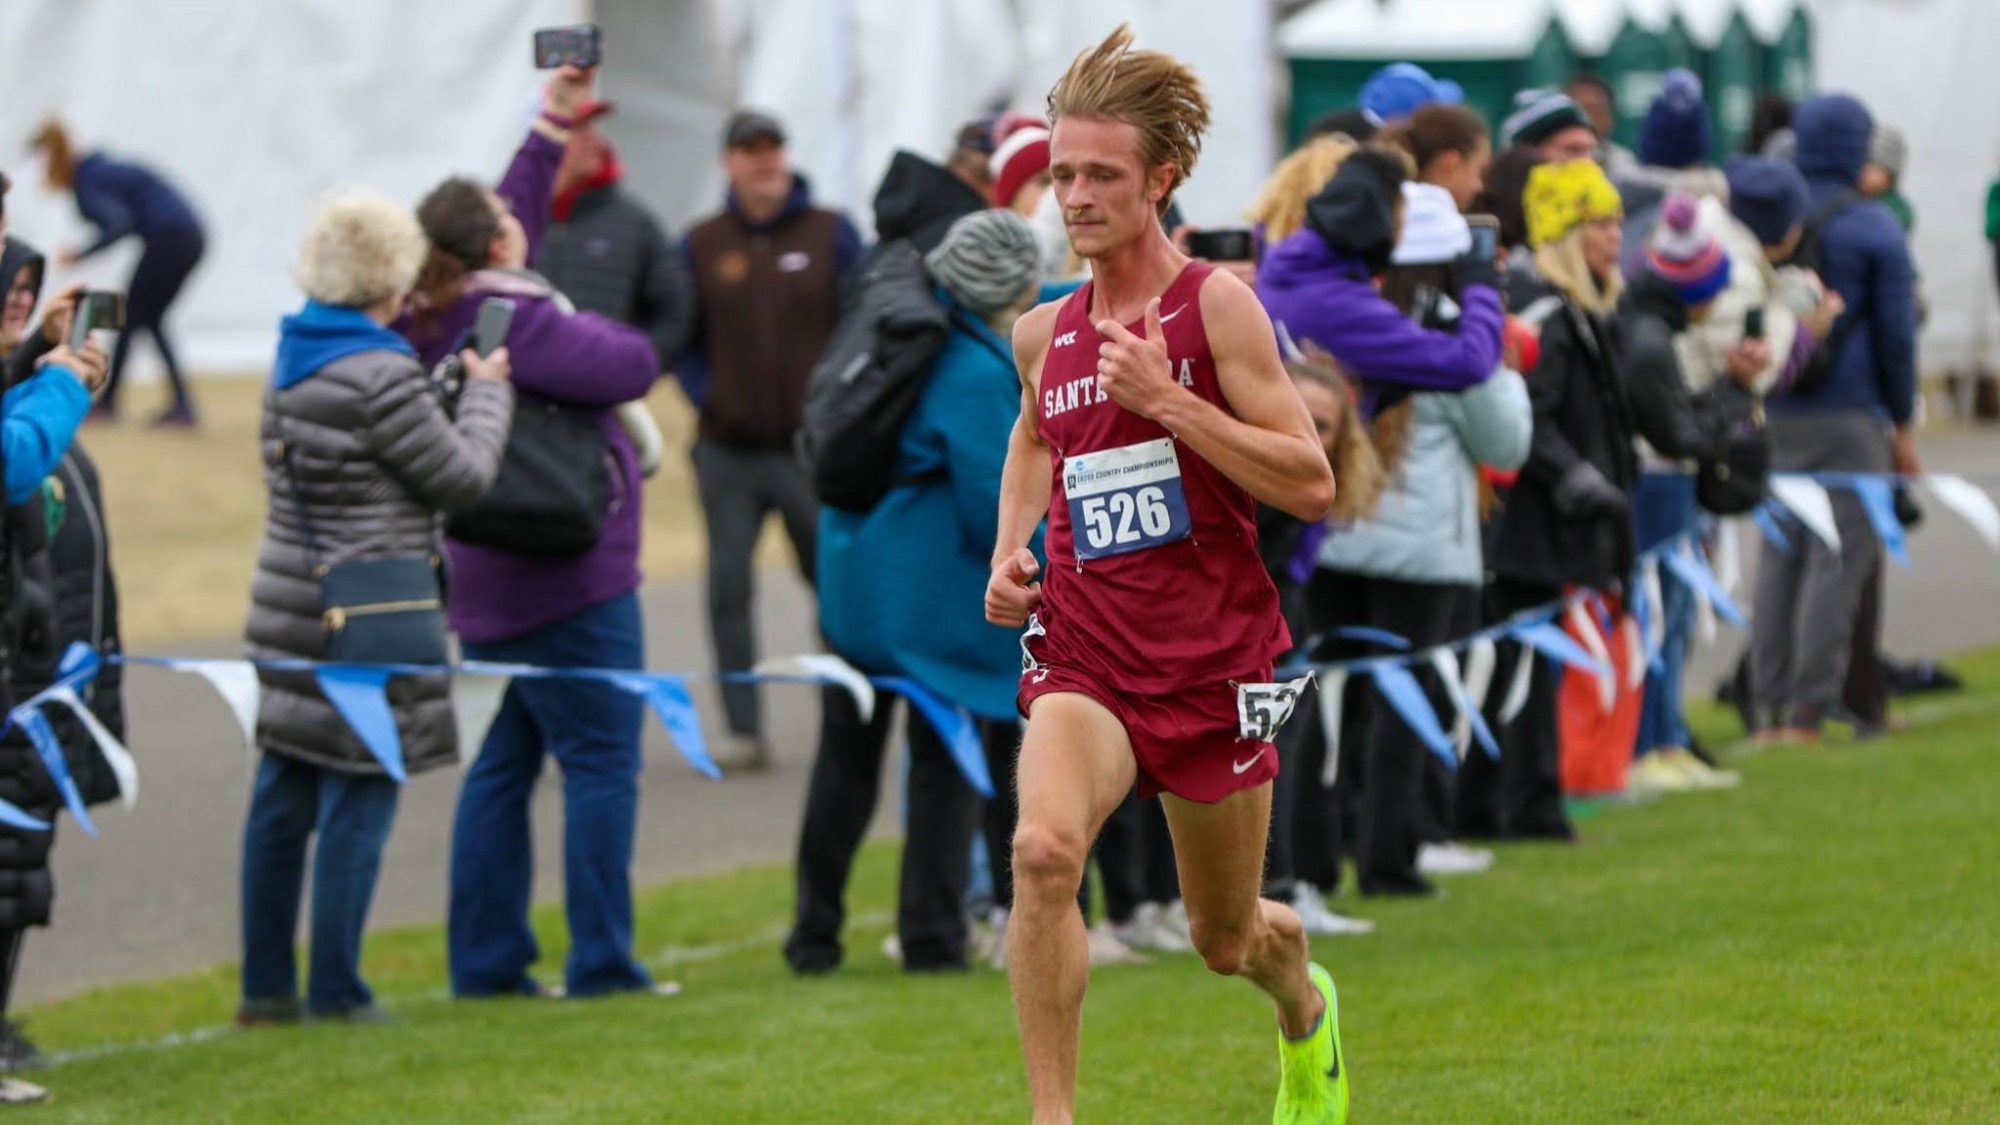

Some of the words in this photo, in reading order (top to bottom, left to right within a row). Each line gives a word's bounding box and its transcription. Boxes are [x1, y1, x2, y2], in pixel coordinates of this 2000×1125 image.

[1095, 467, 1121, 479] COUNTRY
[1123, 456, 1174, 474] CHAMPIONSHIPS
[1081, 486, 1171, 549] 526
